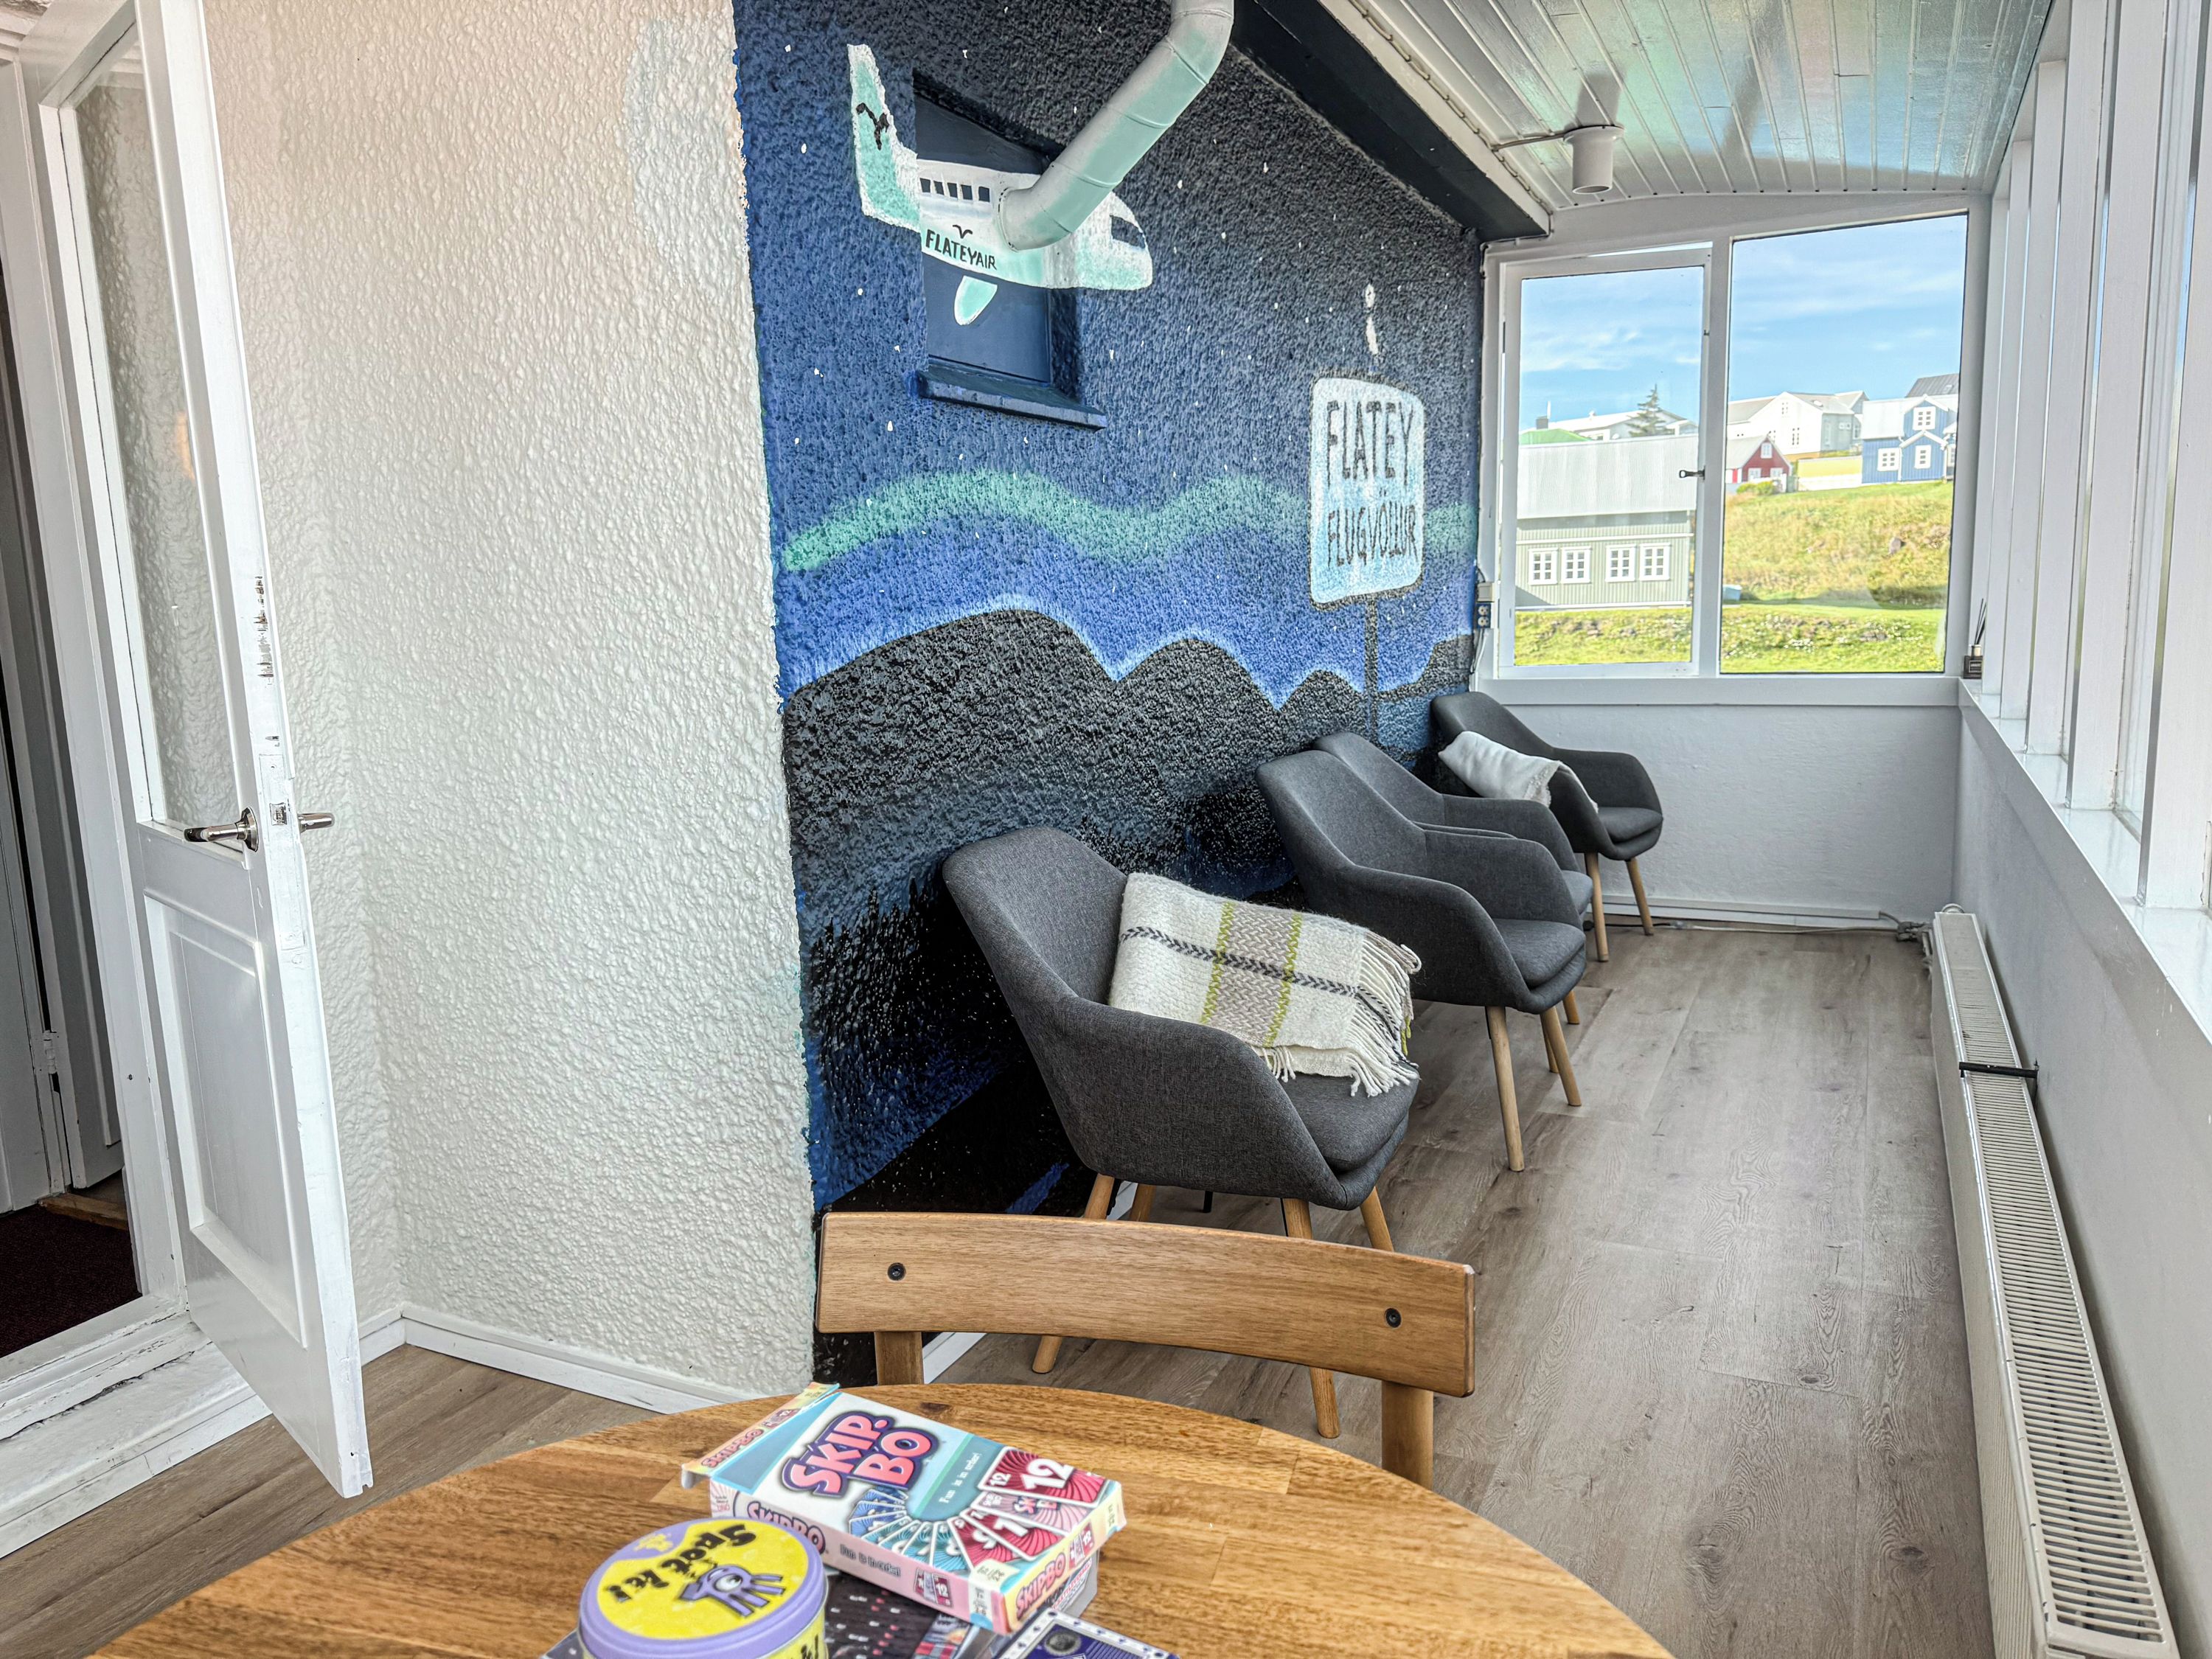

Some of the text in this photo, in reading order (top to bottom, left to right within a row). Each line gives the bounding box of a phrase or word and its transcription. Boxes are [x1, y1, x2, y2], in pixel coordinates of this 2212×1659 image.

[1326, 400, 1414, 489] FLATEY
[851, 1430, 934, 1487] BO
[989, 1472, 1011, 1486] 12
[1020, 1458, 1074, 1489] 12
